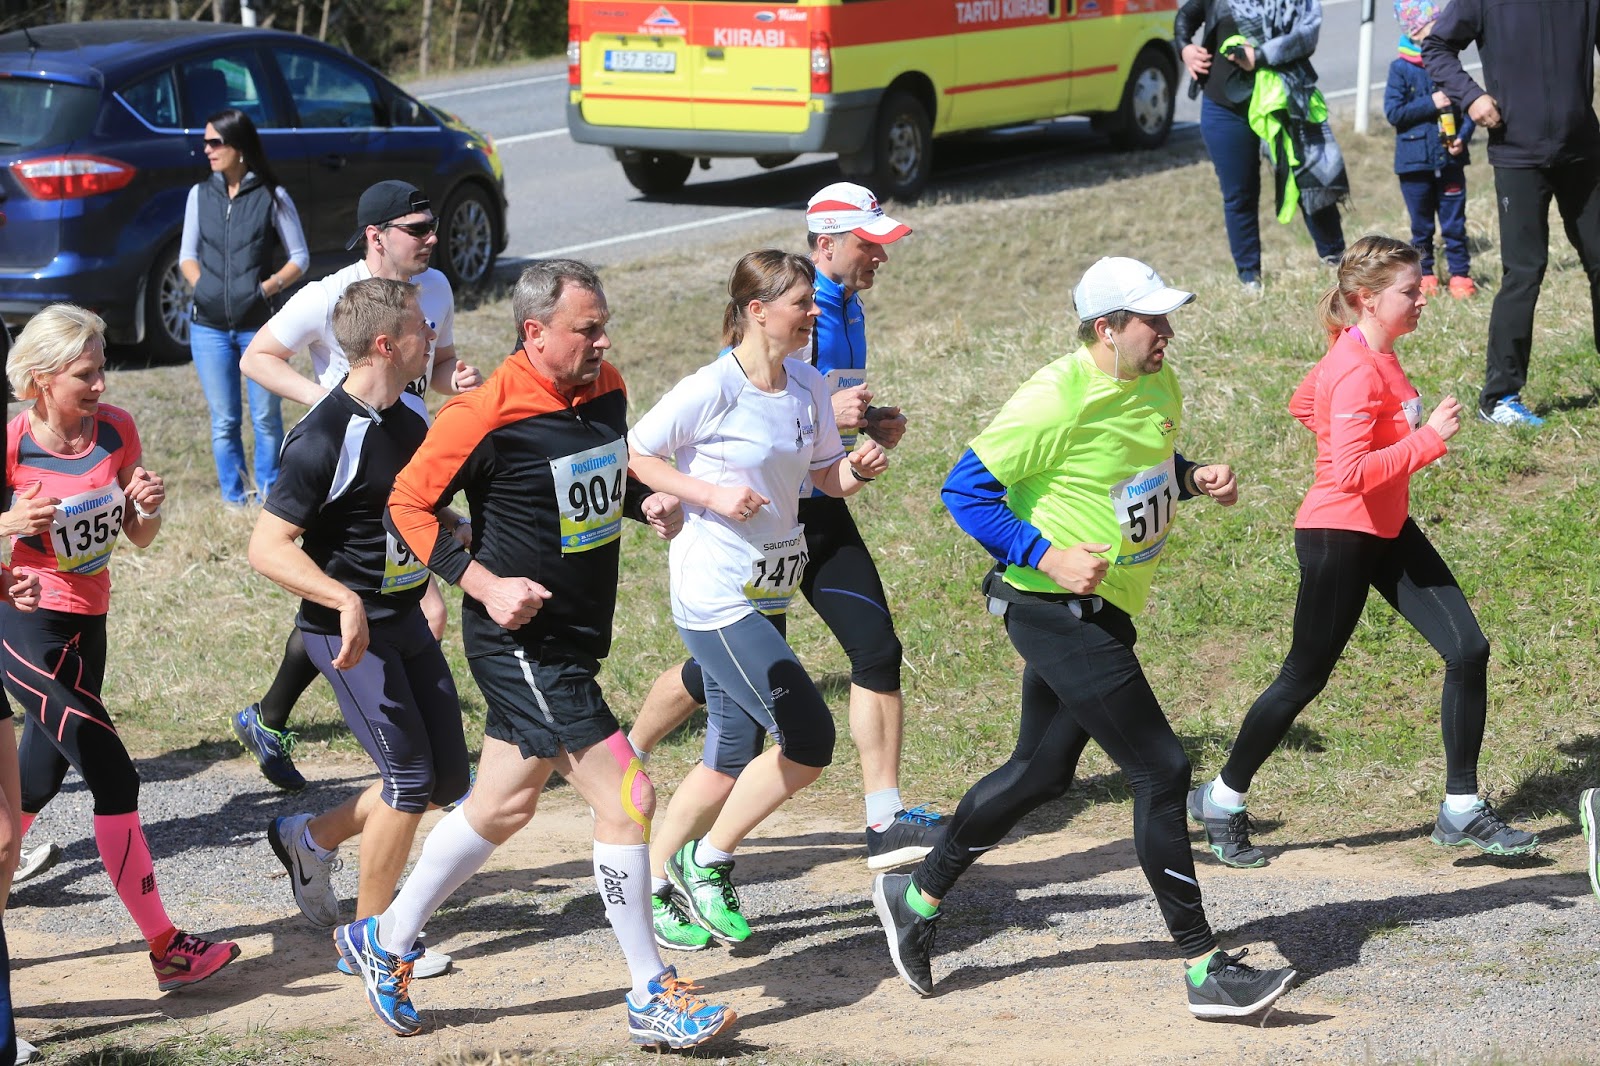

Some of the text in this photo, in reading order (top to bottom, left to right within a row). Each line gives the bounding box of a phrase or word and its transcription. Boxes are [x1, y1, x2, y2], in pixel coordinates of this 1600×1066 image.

[955, 0, 1000, 24] TARTU
[713, 27, 785, 47] KIIRABI
[616, 52, 671, 68] 157 BCJ
[570, 452, 617, 476] Postimees
[568, 468, 622, 523] 904
[1126, 470, 1169, 499] Postimees
[64, 492, 114, 518] Postimees
[1127, 485, 1172, 544] 511
[56, 505, 123, 558] 1353
